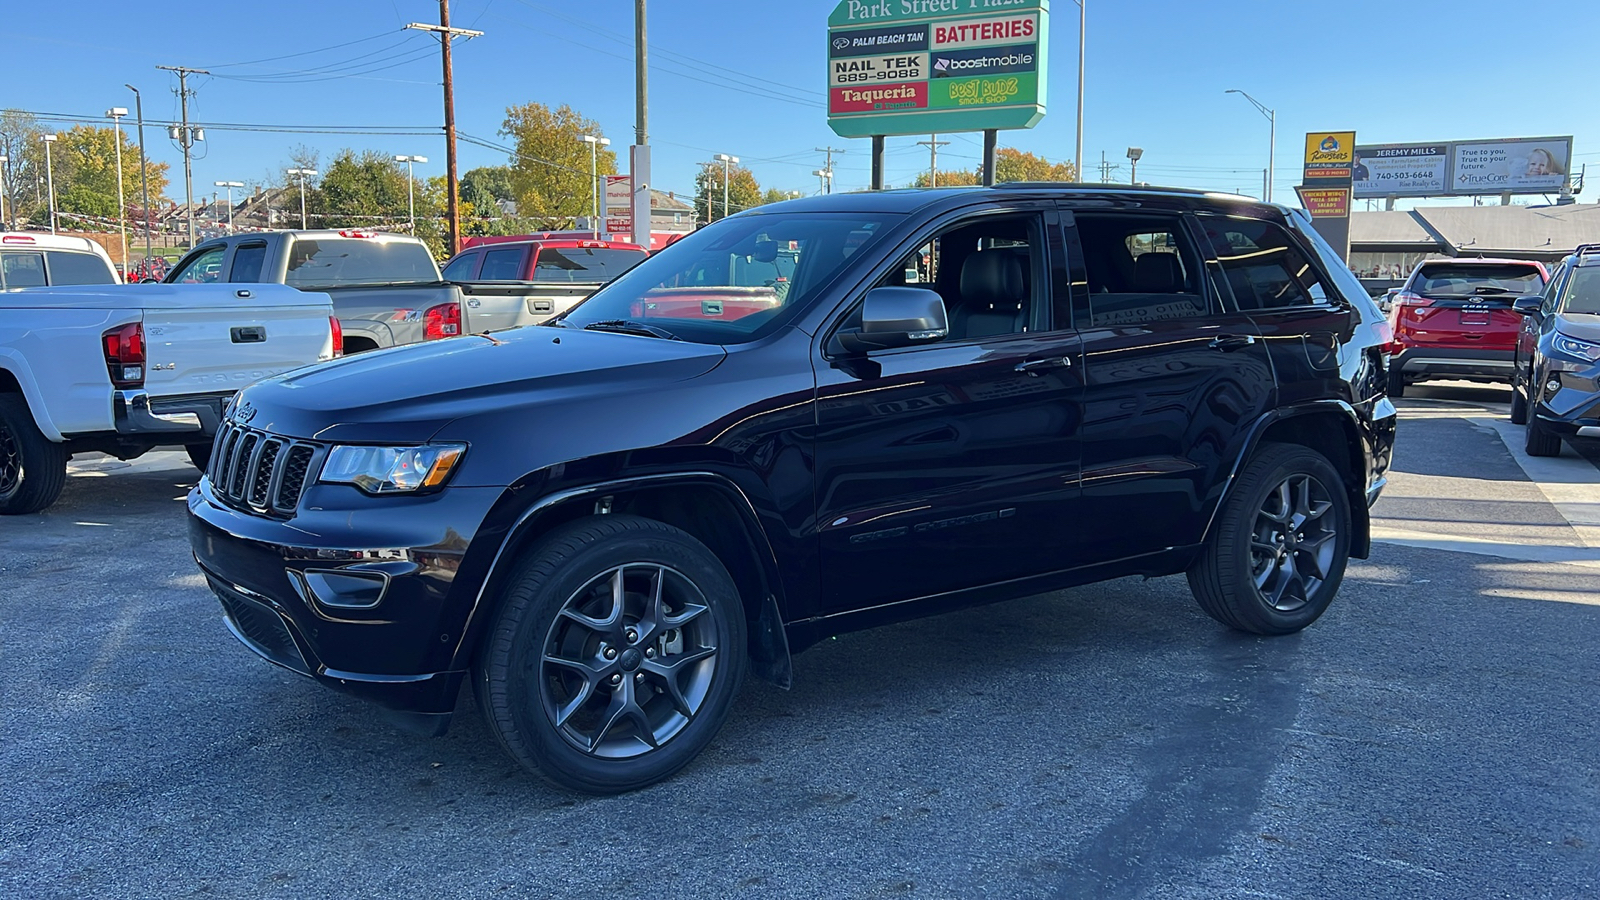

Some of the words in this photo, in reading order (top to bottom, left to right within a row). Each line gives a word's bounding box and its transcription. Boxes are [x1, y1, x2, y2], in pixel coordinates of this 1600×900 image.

[848, 0, 892, 20] Park
[901, 0, 959, 15] Street
[936, 19, 1034, 44] BATTERIES
[852, 36, 875, 47] PALM
[877, 34, 905, 45] BEACH
[907, 32, 924, 42] TAN
[835, 60, 875, 73] NAIL
[883, 56, 920, 69] TEK
[837, 69, 919, 83] 689-9088
[959, 97, 985, 106] SMOKE
[986, 95, 1007, 104] SHOP
[1310, 150, 1348, 162] Roosters
[1376, 149, 1409, 157] JEREMY
[1411, 147, 1436, 155] MILLS
[1376, 171, 1434, 180] 740-503-6648
